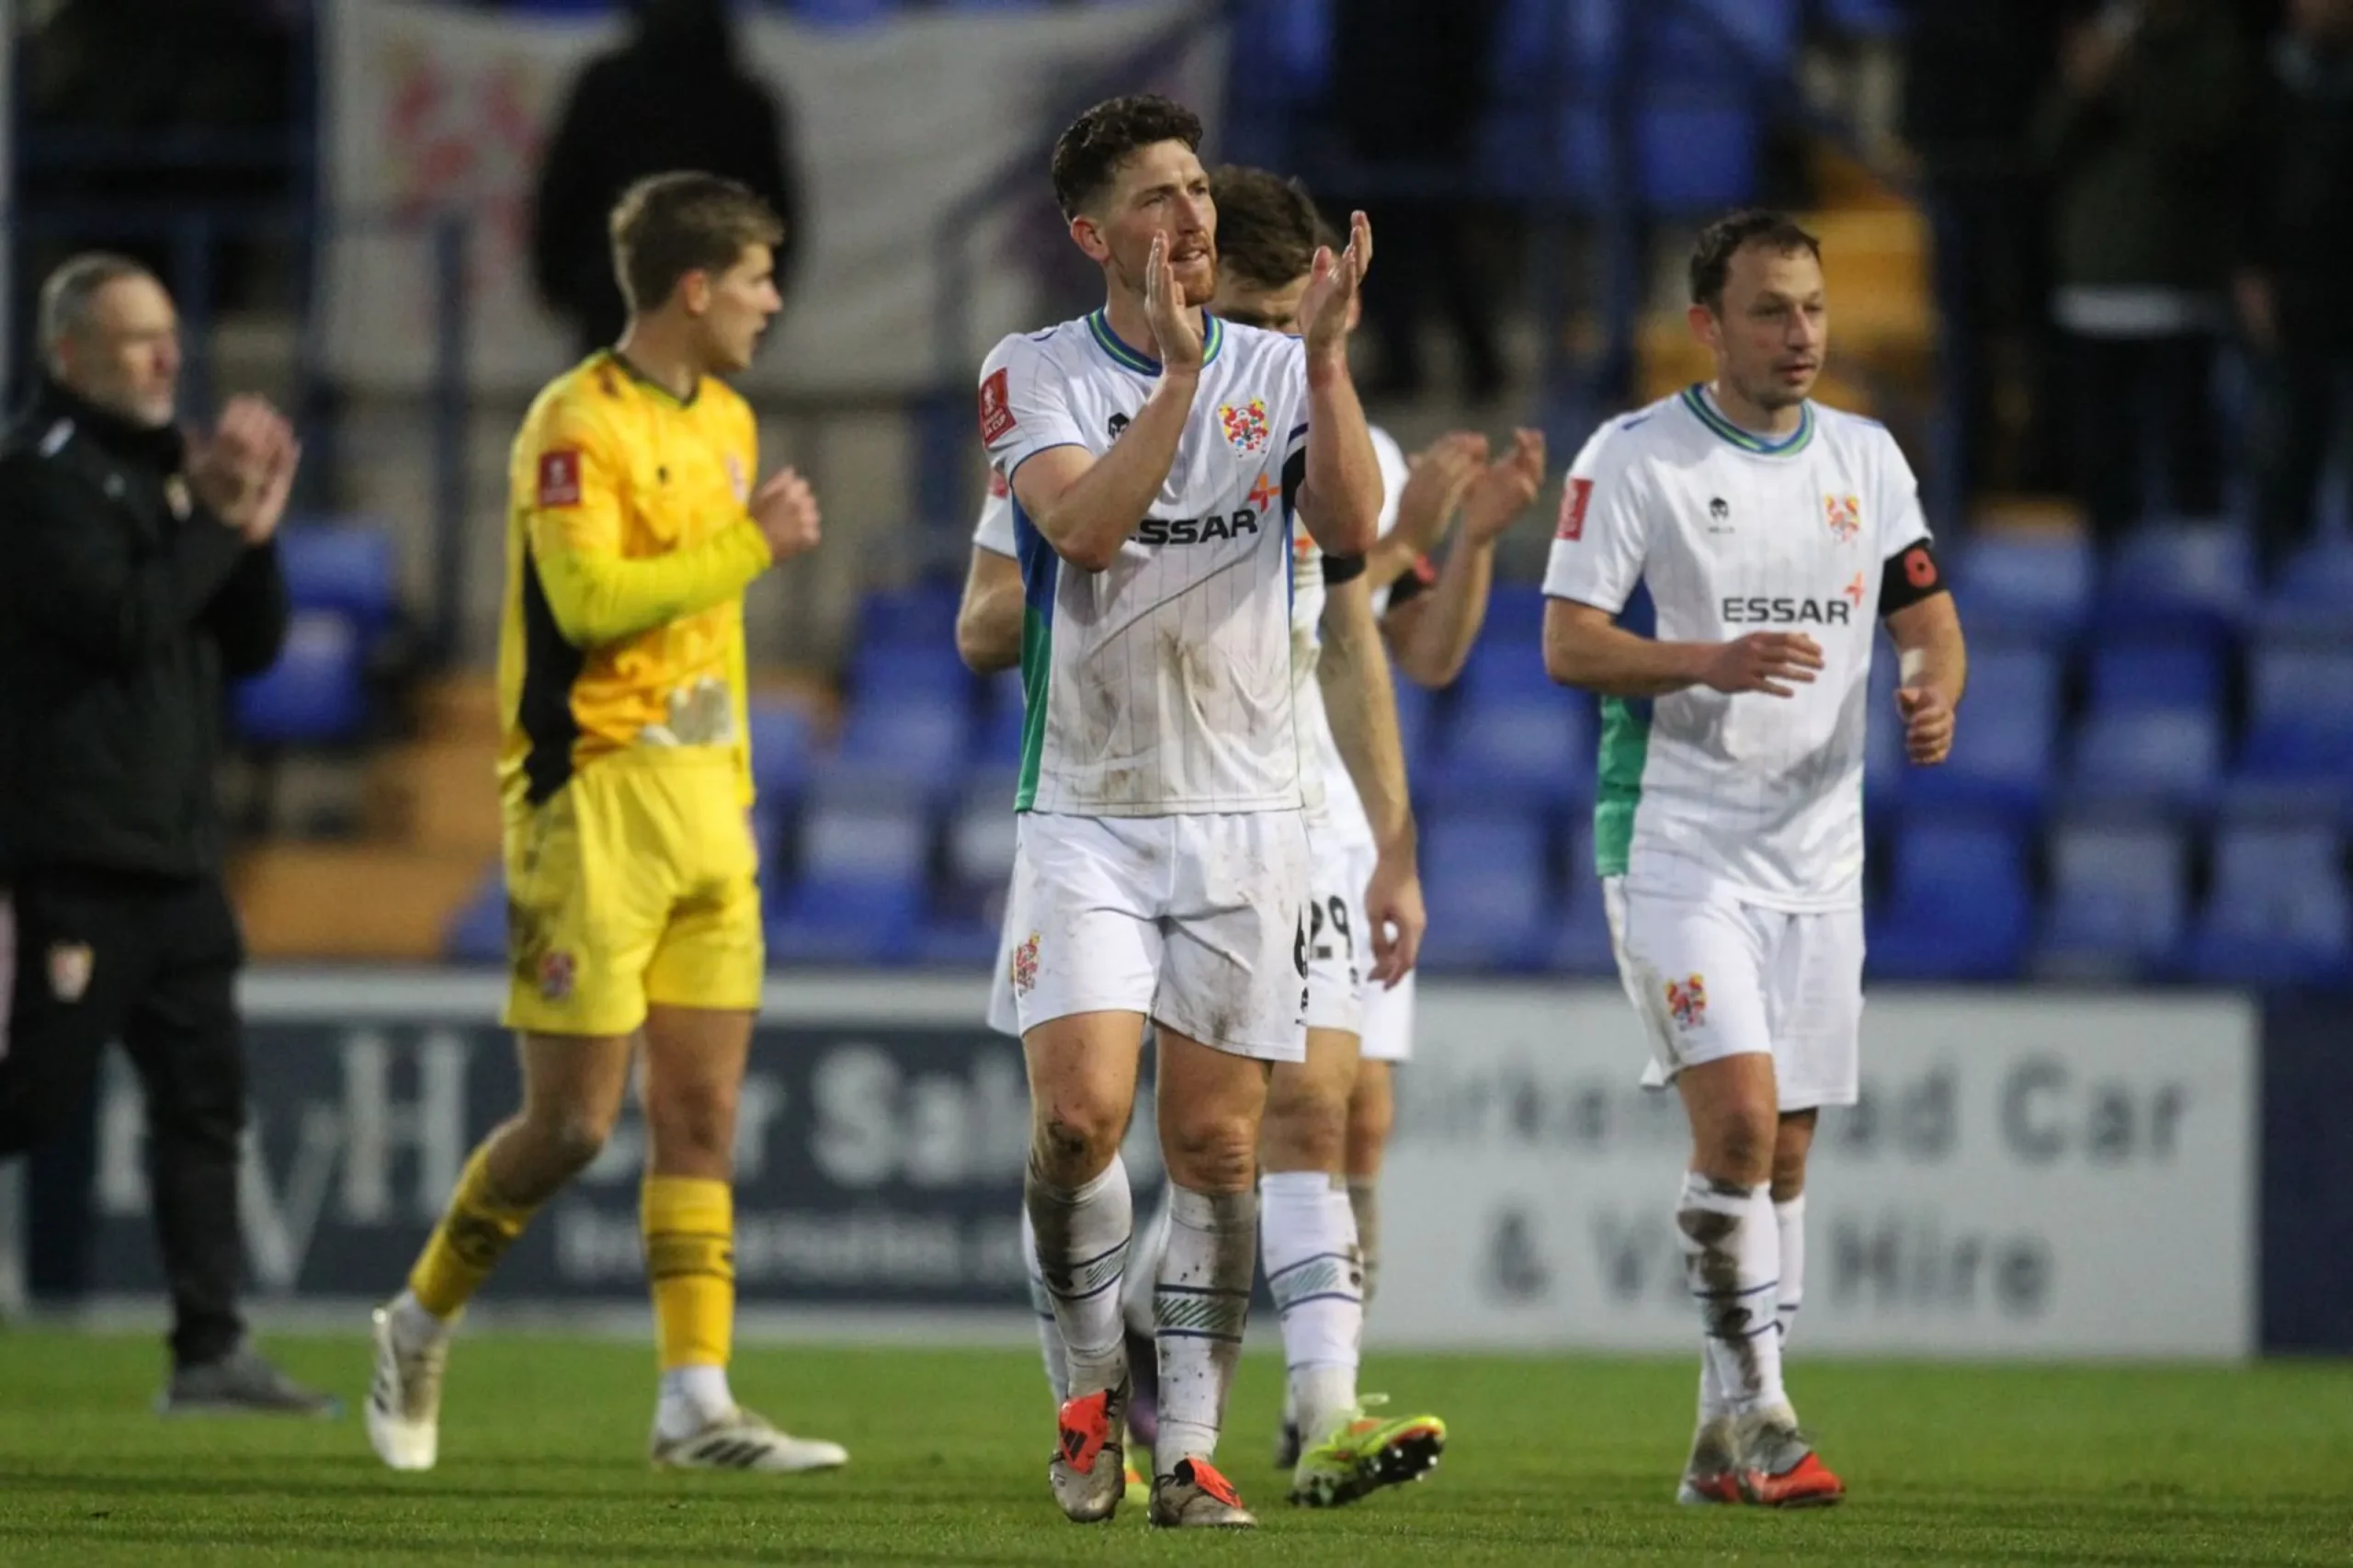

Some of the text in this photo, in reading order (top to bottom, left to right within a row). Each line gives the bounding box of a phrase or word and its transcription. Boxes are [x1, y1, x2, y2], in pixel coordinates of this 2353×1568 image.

[1130, 509, 1258, 545] SSAR
[1722, 597, 1849, 625] ESSAR
[2001, 1050, 2183, 1160] Car
[1487, 1208, 1550, 1301] &
[1827, 1218, 2052, 1314] Hire
